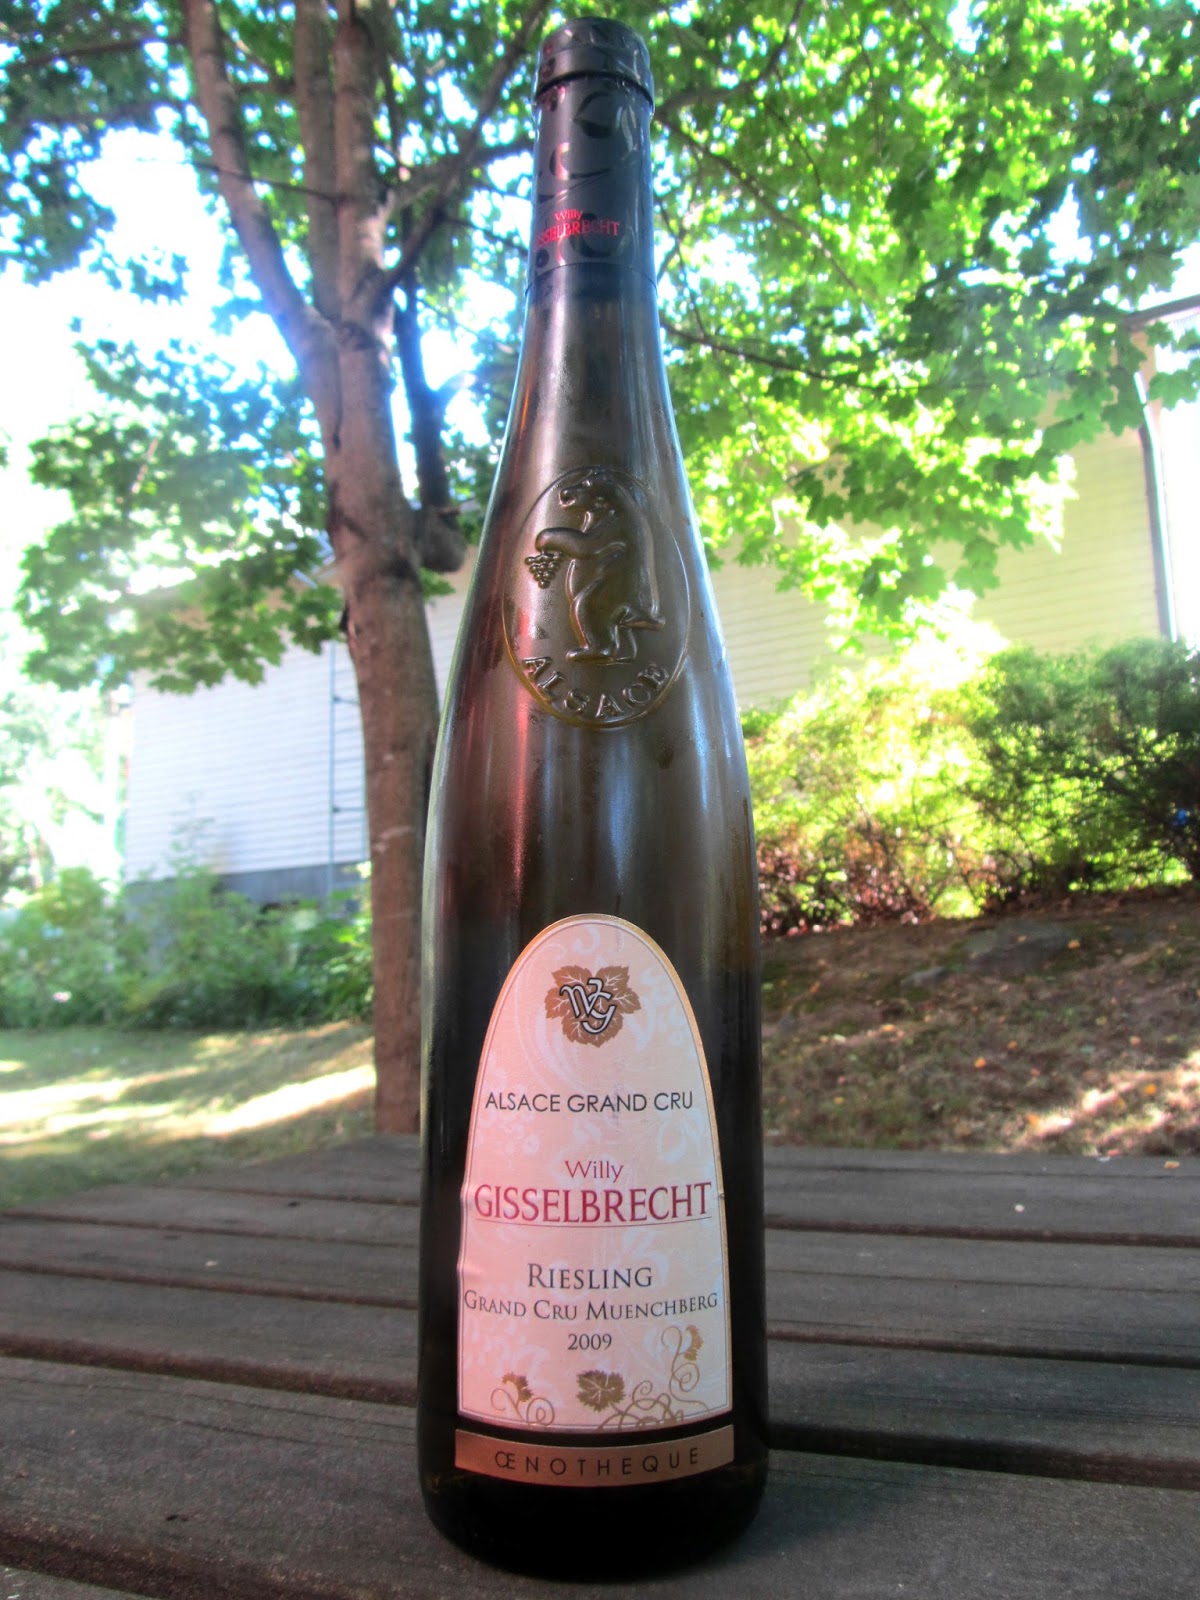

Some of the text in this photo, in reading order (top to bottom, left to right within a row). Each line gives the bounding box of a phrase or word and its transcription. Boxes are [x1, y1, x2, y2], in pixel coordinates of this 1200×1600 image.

[555, 209, 582, 220] Willy
[522, 656, 669, 719] ALSACE
[485, 1091, 694, 1113] ALSACE GRAND CRU
[564, 1160, 625, 1183] Willy
[474, 1181, 713, 1224] GISSELBRECHT
[527, 1263, 653, 1290] RIESLING
[464, 1290, 719, 1321] GRAND CRU MUENCHBERG
[567, 1334, 613, 1351] 2009
[494, 1447, 699, 1477] ŒNOTHEQUE
